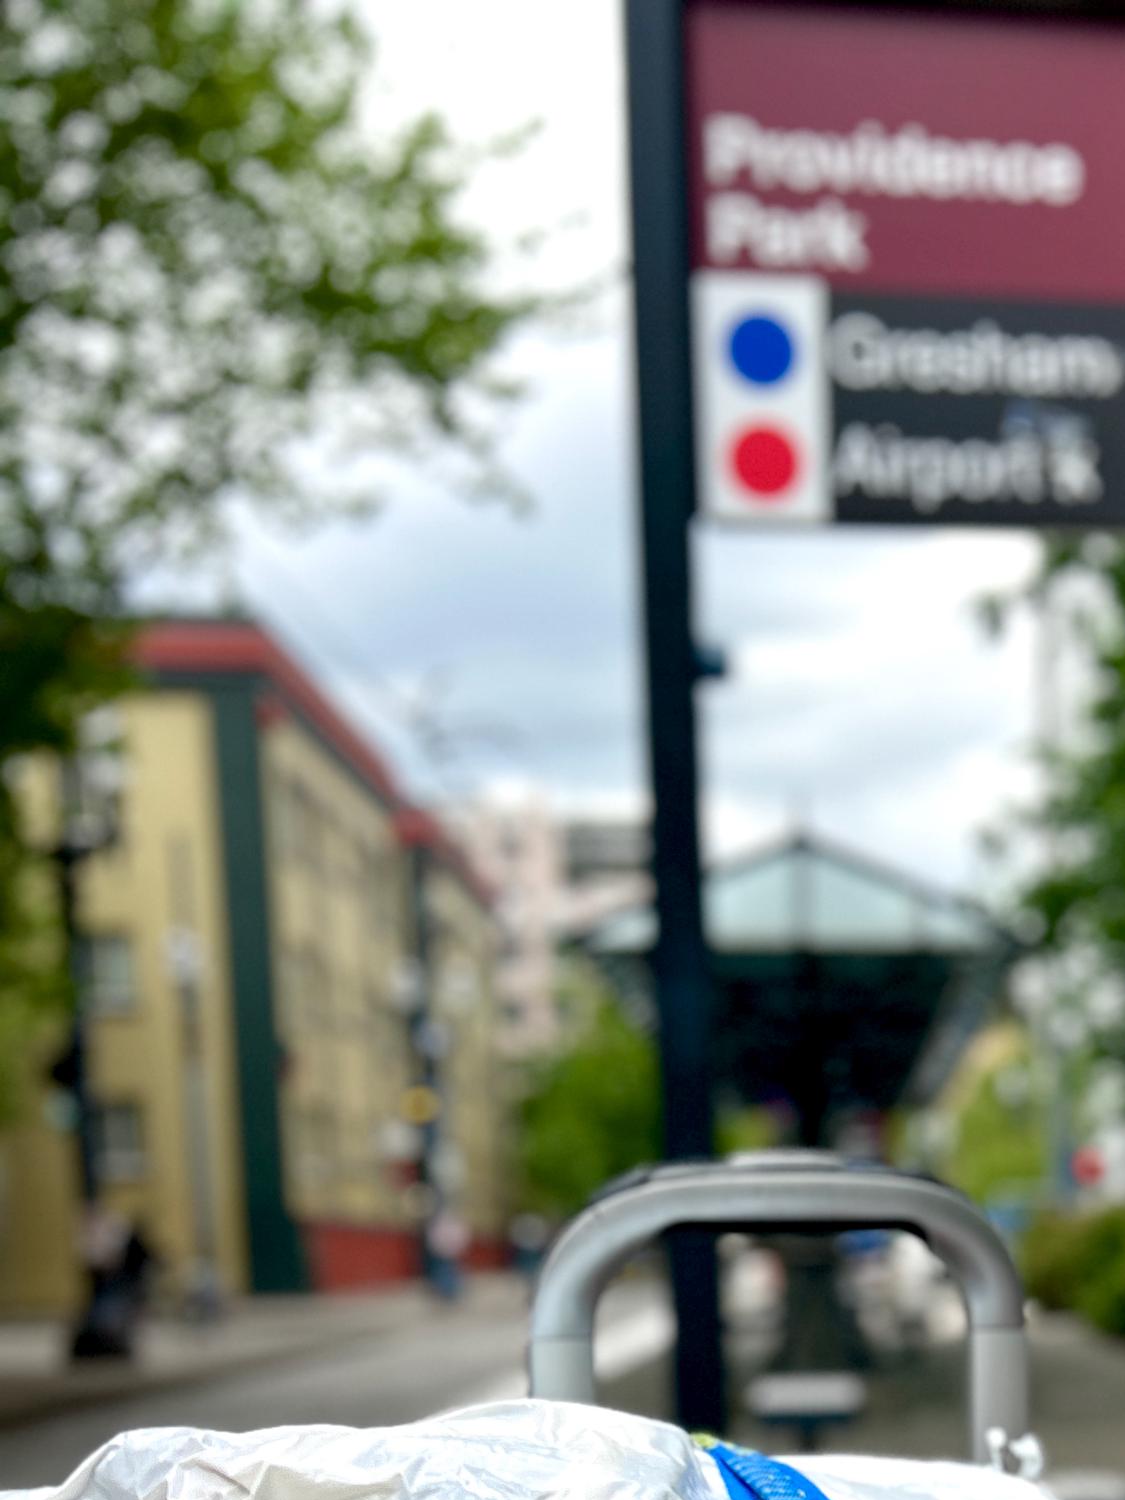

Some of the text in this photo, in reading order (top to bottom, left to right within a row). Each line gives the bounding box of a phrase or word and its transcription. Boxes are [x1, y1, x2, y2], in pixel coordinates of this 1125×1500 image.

[704, 114, 1083, 205] Providence
[706, 193, 870, 272] Park
[829, 312, 1122, 398] Gresham
[834, 422, 1044, 513] Airport
